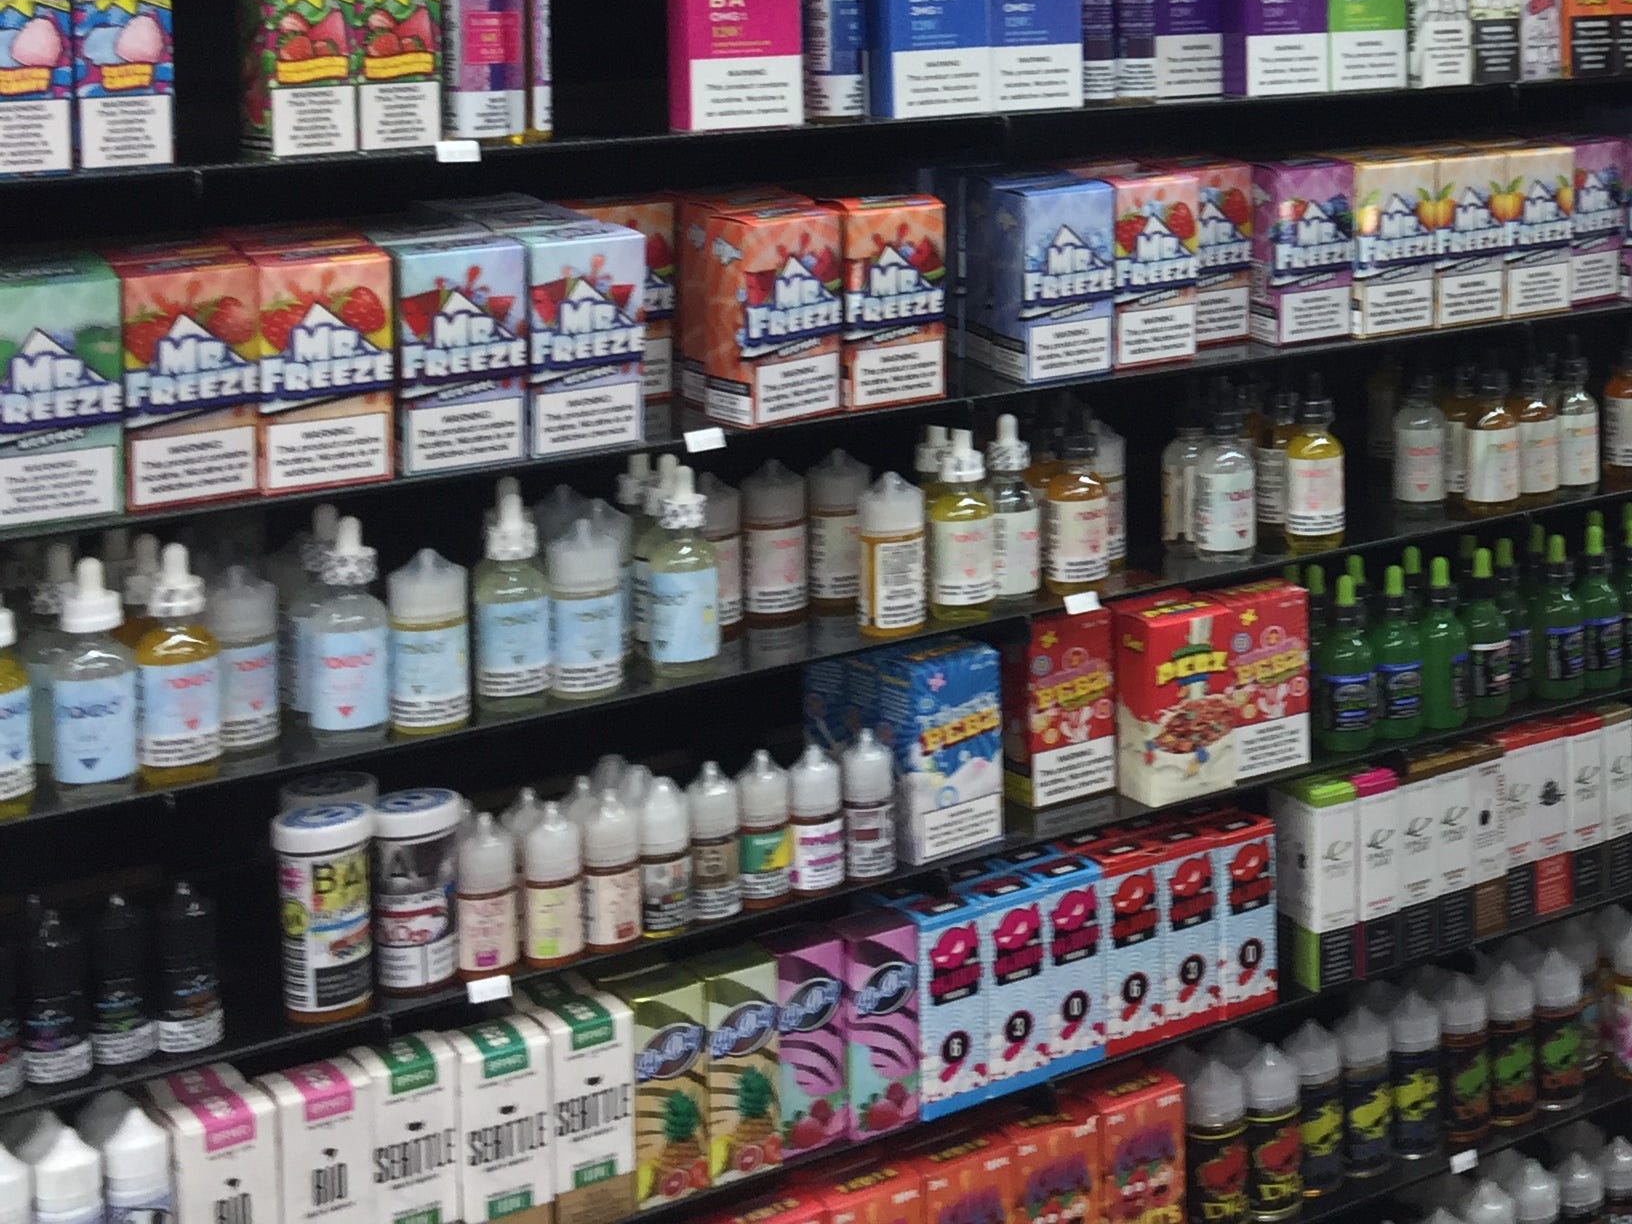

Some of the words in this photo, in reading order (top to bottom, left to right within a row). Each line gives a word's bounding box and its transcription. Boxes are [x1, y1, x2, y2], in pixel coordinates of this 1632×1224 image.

[1024, 267, 1115, 301] FREEZE
[1115, 256, 1199, 288] FREEZE
[747, 298, 843, 339] FREEZE
[845, 287, 944, 323] FREEZE
[402, 337, 527, 379] FREEZE
[532, 325, 646, 364] FREEZE
[125, 364, 259, 408] FREEZE
[260, 350, 393, 394] FREEZE
[1, 382, 124, 424] REEZE
[556, 1083, 632, 1137] SEATTLE
[374, 1128, 456, 1183] SEATTLE
[467, 1113, 547, 1167] SEATTLE
